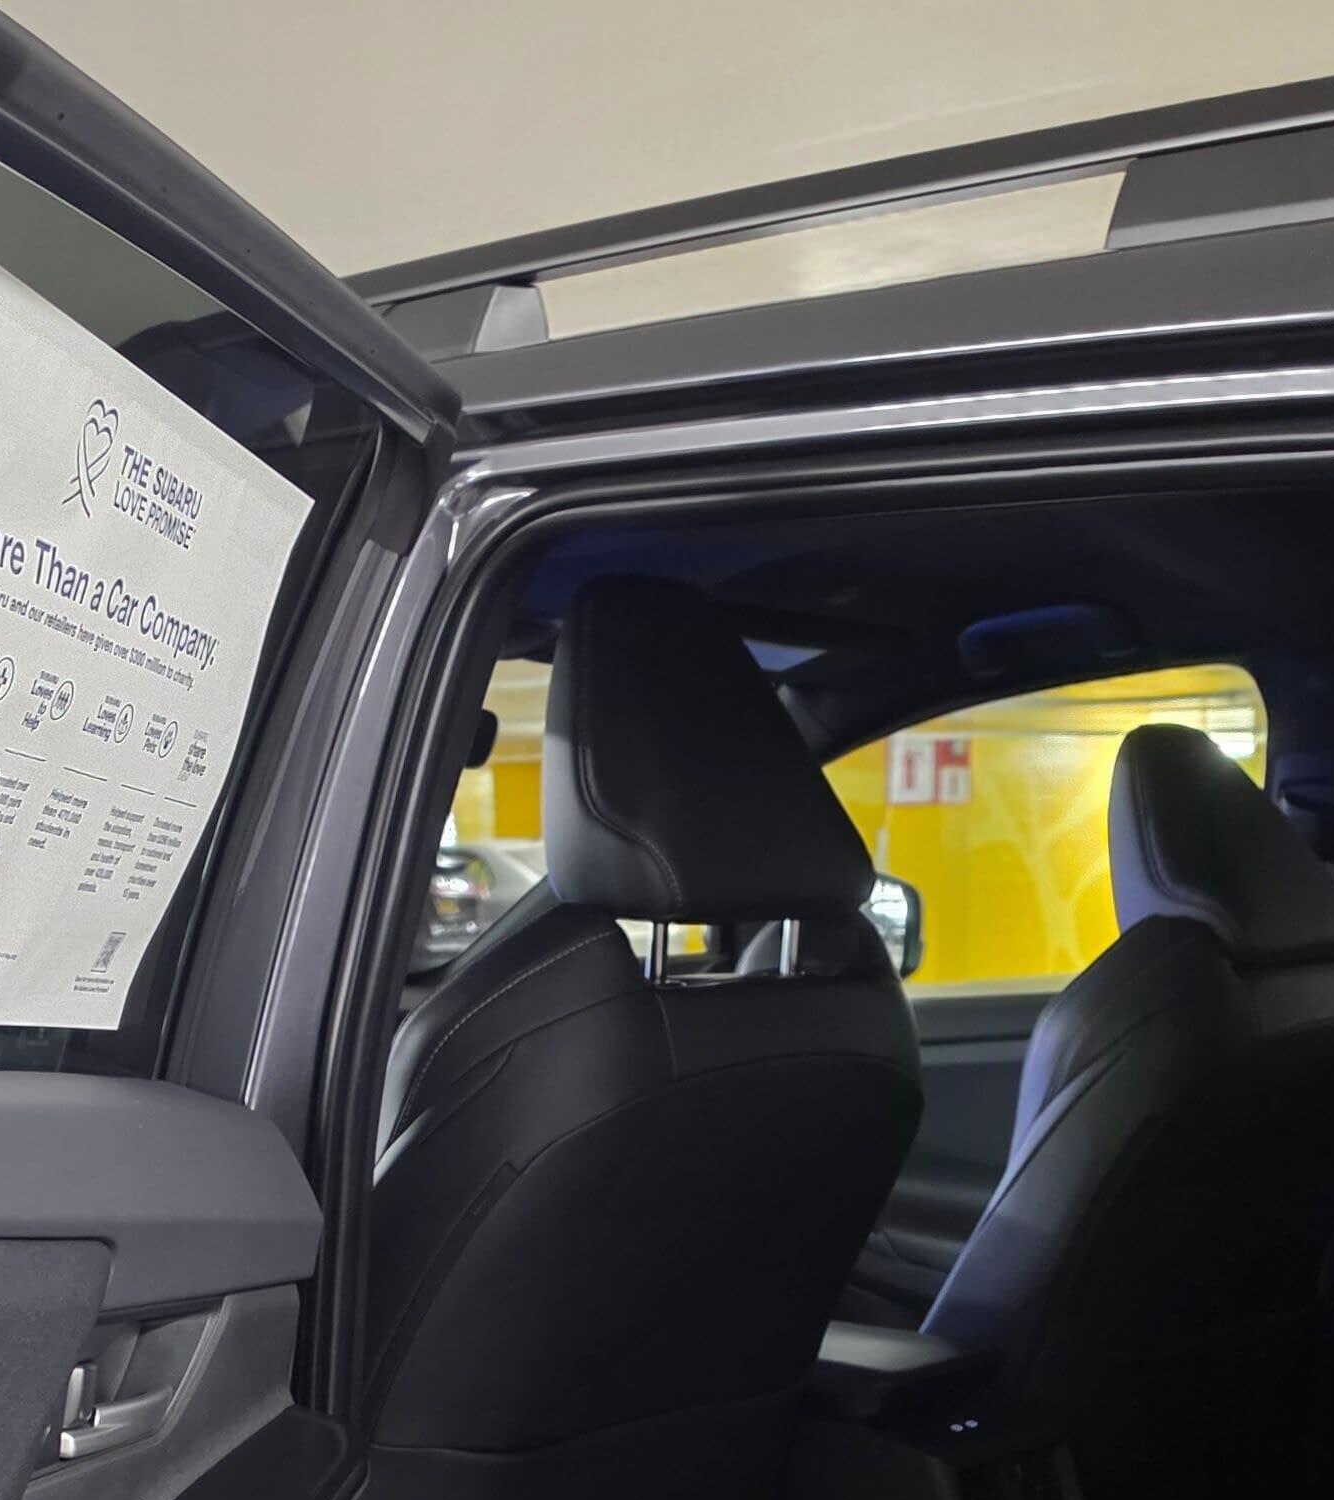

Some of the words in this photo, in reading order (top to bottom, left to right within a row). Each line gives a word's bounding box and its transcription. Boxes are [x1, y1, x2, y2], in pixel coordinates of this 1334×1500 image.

[122, 446, 152, 488] THE
[153, 467, 202, 519] SUBARU
[114, 481, 147, 521] LOVE
[36, 540, 88, 604] Than
[91, 581, 104, 611] a
[107, 579, 139, 626] Car
[141, 596, 219, 670] Company.
[10, 599, 29, 615] and
[29, 607, 45, 622] our
[44, 614, 77, 637] retailers
[77, 624, 94, 645] have
[94, 634, 113, 653] given
[114, 645, 129, 659] over
[145, 657, 166, 675] million
[166, 665, 173, 679] to
[173, 669, 194, 691] charity.
[31, 680, 54, 700] Loves
[38, 702, 46, 714] to
[97, 705, 116, 723] Loves
[22, 712, 39, 732] Help
[83, 718, 112, 741] Learning
[145, 722, 162, 739] Loves
[50, 788, 74, 803] Helped
[72, 798, 87, 808] more
[43, 806, 57, 817] than
[35, 822, 63, 836] students
